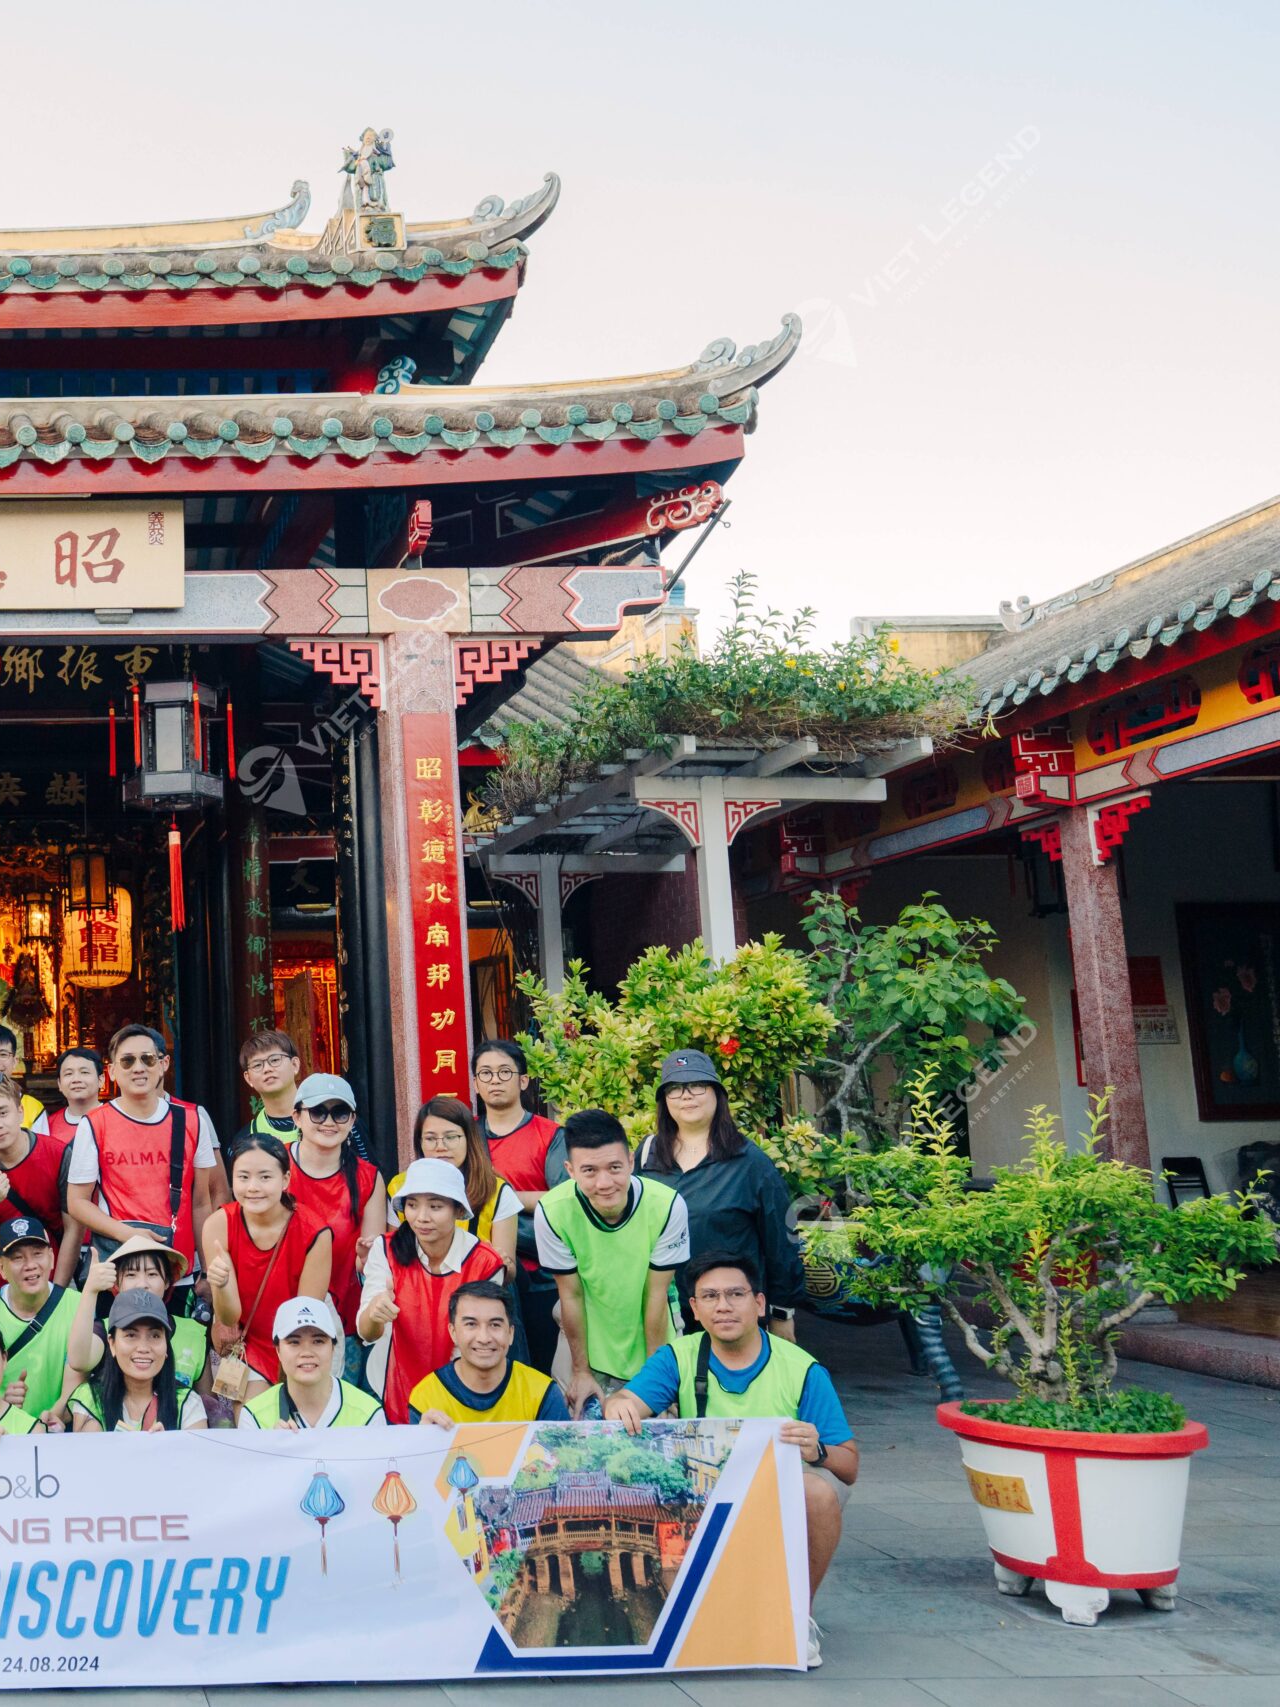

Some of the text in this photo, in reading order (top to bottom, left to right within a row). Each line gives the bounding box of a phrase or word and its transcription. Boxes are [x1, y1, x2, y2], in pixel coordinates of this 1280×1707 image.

[416, 757, 457, 1097] 昭彰德化南邦功同
[105, 1151, 190, 1165] BALMA
[64, 1514, 190, 1544] RACE
[2, 1656, 100, 1673] 24.08.2024
